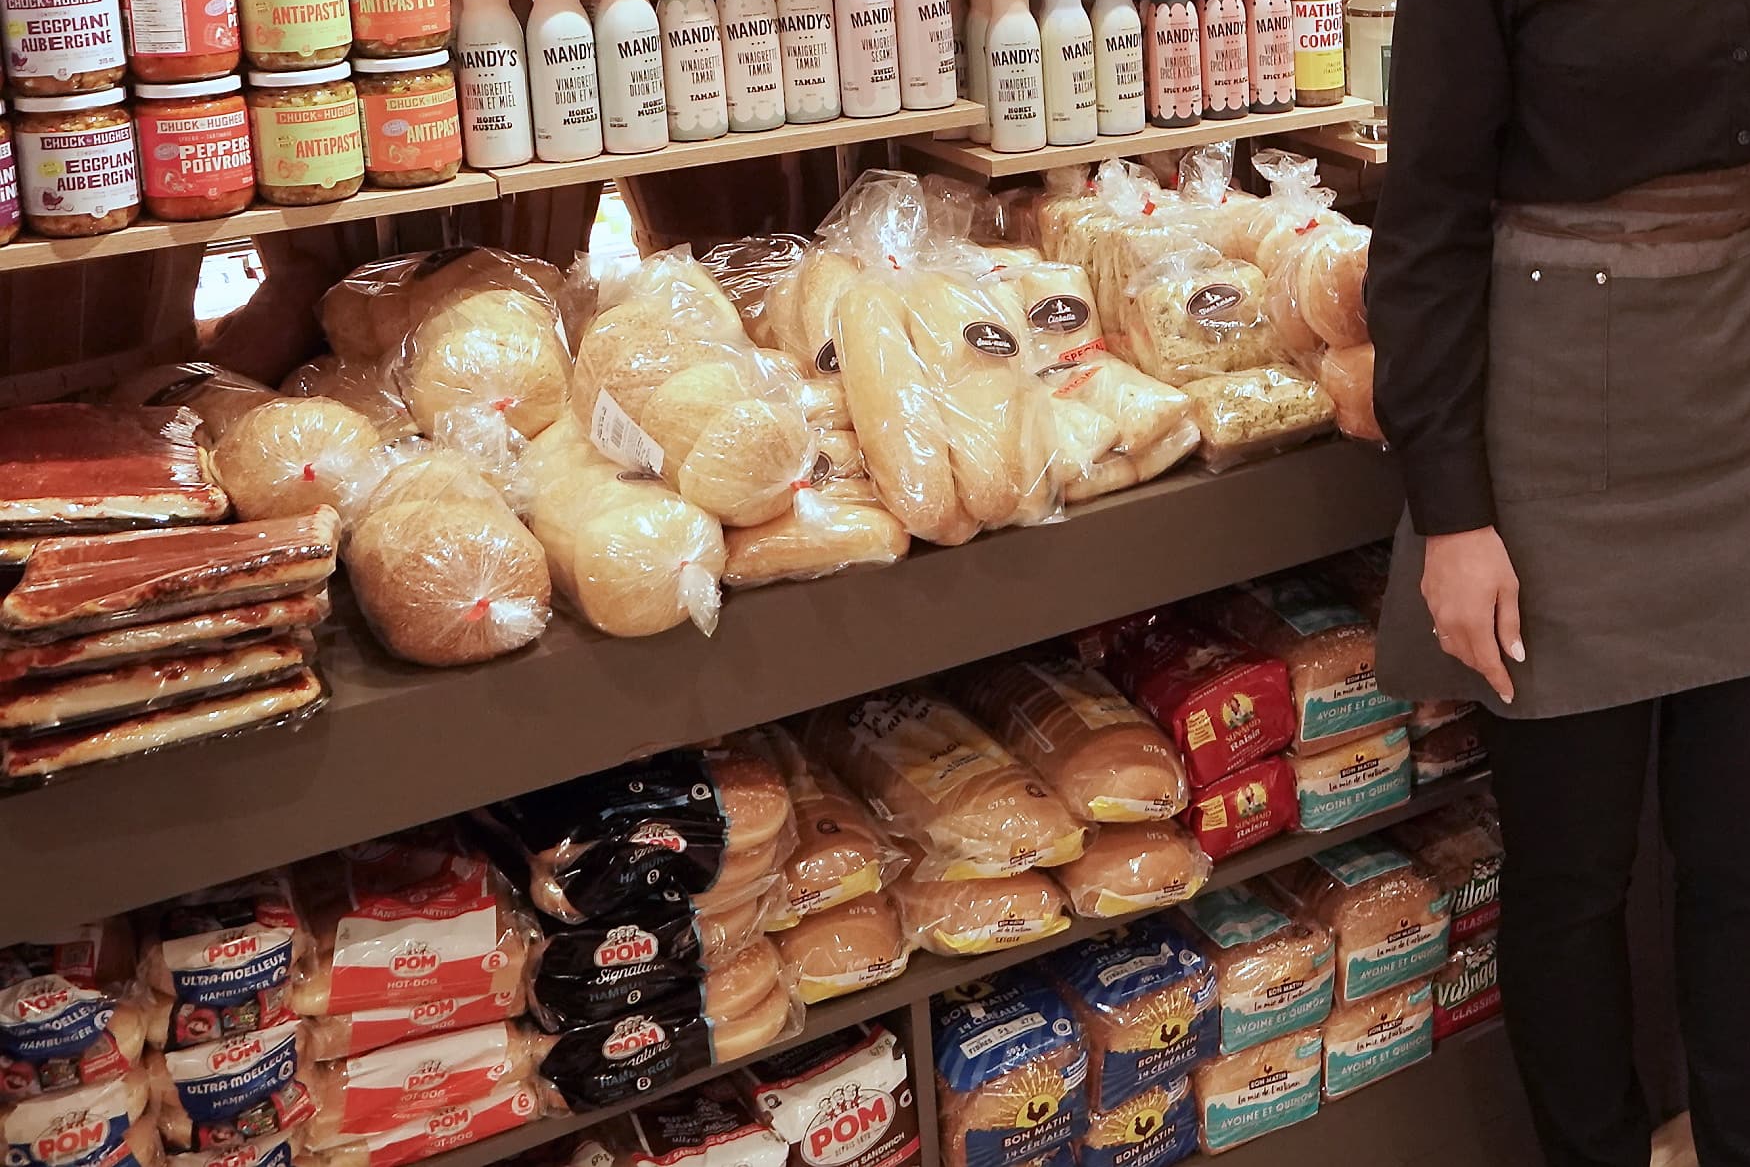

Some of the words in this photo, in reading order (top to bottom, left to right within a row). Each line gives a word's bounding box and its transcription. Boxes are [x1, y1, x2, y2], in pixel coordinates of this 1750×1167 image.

[27, 13, 109, 35] EGGPLANT
[778, 13, 831, 33] MANDY'S
[786, 42, 828, 58] VINAIGRETTE
[992, 48, 1040, 67] MANDY'S
[748, 63, 773, 77] TAMARI
[795, 56, 821, 70] TAMARI
[466, 81, 512, 97] VINAIGRETTE
[746, 83, 777, 94] TAMARI
[794, 77, 826, 86] TAMARI
[390, 97, 425, 109] CHUCK
[487, 96, 496, 108] ET
[500, 94, 516, 108] MIEL
[160, 121, 200, 132] CHUCK
[207, 113, 243, 128] HUGHES
[279, 112, 316, 123] CHUCK
[324, 103, 356, 120] HUGHES
[44, 136, 86, 149] CHUCK
[94, 129, 130, 144] HUGHES
[178, 136, 250, 160] PEPPERS
[1230, 729, 1260, 752] Raisin
[1355, 793, 1365, 803] ET
[1236, 820, 1269, 839] Raisin
[208, 937, 257, 963] POM
[601, 939, 653, 965] POM
[182, 953, 287, 986] ULTRA-MOELLEUX
[394, 955, 436, 970] POM
[488, 954, 501, 968] 6
[387, 978, 438, 989] HOT-DOG
[413, 1000, 454, 1020] POM
[1276, 1012, 1287, 1023] ET
[211, 1041, 263, 1070] POM
[1137, 1051, 1162, 1068] BON
[1164, 1034, 1197, 1062] MATIN
[1384, 1051, 1396, 1063] ET
[1266, 1072, 1287, 1085] MATIN
[517, 1093, 530, 1109] 6
[429, 1109, 469, 1132] POM
[810, 1097, 888, 1157] POM
[1221, 1110, 1260, 1129] AVOINE
[1262, 1106, 1273, 1118] ET
[1004, 1133, 1030, 1147] BON
[1034, 1112, 1071, 1141] MATIN
[38, 1122, 104, 1160] POM
[1115, 1145, 1140, 1163] BON
[1143, 1124, 1175, 1154] MATIN
